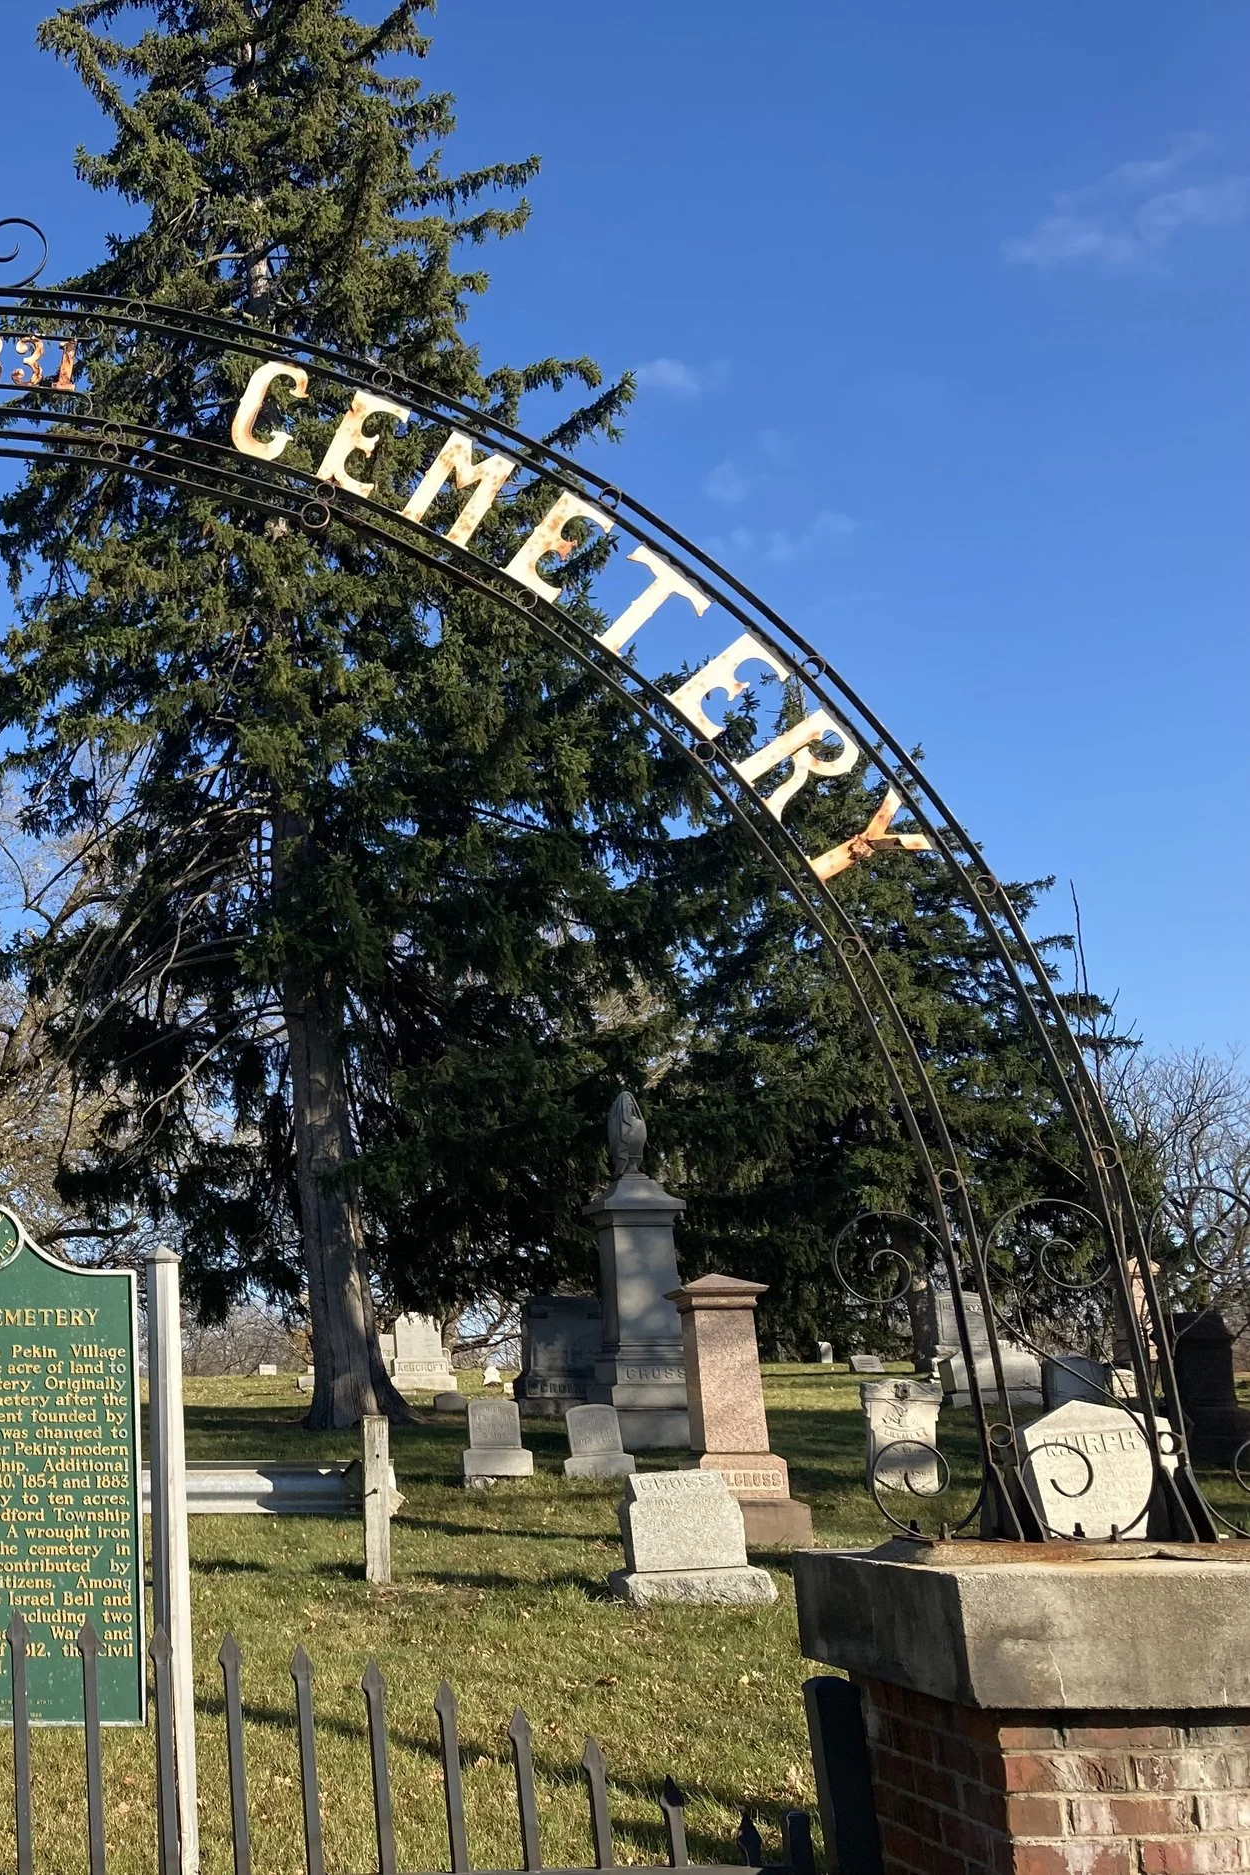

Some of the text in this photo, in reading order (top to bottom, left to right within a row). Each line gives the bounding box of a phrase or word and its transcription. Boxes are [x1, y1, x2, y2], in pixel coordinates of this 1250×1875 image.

[230, 361, 936, 881] CEMETERY
[12, 1347, 57, 1359] Pekin
[71, 1347, 126, 1363] Village
[7, 1365, 42, 1375] acre
[47, 1361, 64, 1375] of
[70, 1361, 104, 1375] land
[109, 1361, 126, 1375] to
[626, 1367, 687, 1380] CROSS
[45, 1377, 126, 1395] Originally
[55, 1392, 96, 1406] after
[102, 1392, 128, 1406] the
[31, 1409, 97, 1422] founded
[105, 1409, 127, 1426] by
[0, 1430, 28, 1439] was
[35, 1426, 102, 1443] changed
[110, 1426, 128, 1439] to
[14, 1442, 67, 1456] Pekin's
[70, 1442, 129, 1456] modern
[43, 1458, 129, 1472] Additional
[22, 1475, 58, 1488] 1854
[63, 1475, 91, 1488] and
[640, 1474, 713, 1491] CROSS
[22, 1491, 39, 1504] to
[48, 1491, 74, 1504] ten
[54, 1507, 131, 1525] Township
[7, 1524, 19, 1538] A
[25, 1524, 91, 1542] wrought
[97, 1524, 130, 1538] iron
[29, 1541, 103, 1559] cemetery
[115, 1541, 130, 1555] in
[110, 1558, 130, 1576] by
[76, 1575, 132, 1593] Among
[8, 1591, 55, 1605] Israel
[62, 1591, 96, 1605] Bell
[103, 1591, 132, 1605] and
[20, 1608, 87, 1626] ncluding
[103, 1608, 133, 1622] two
[104, 1625, 133, 1639] and
